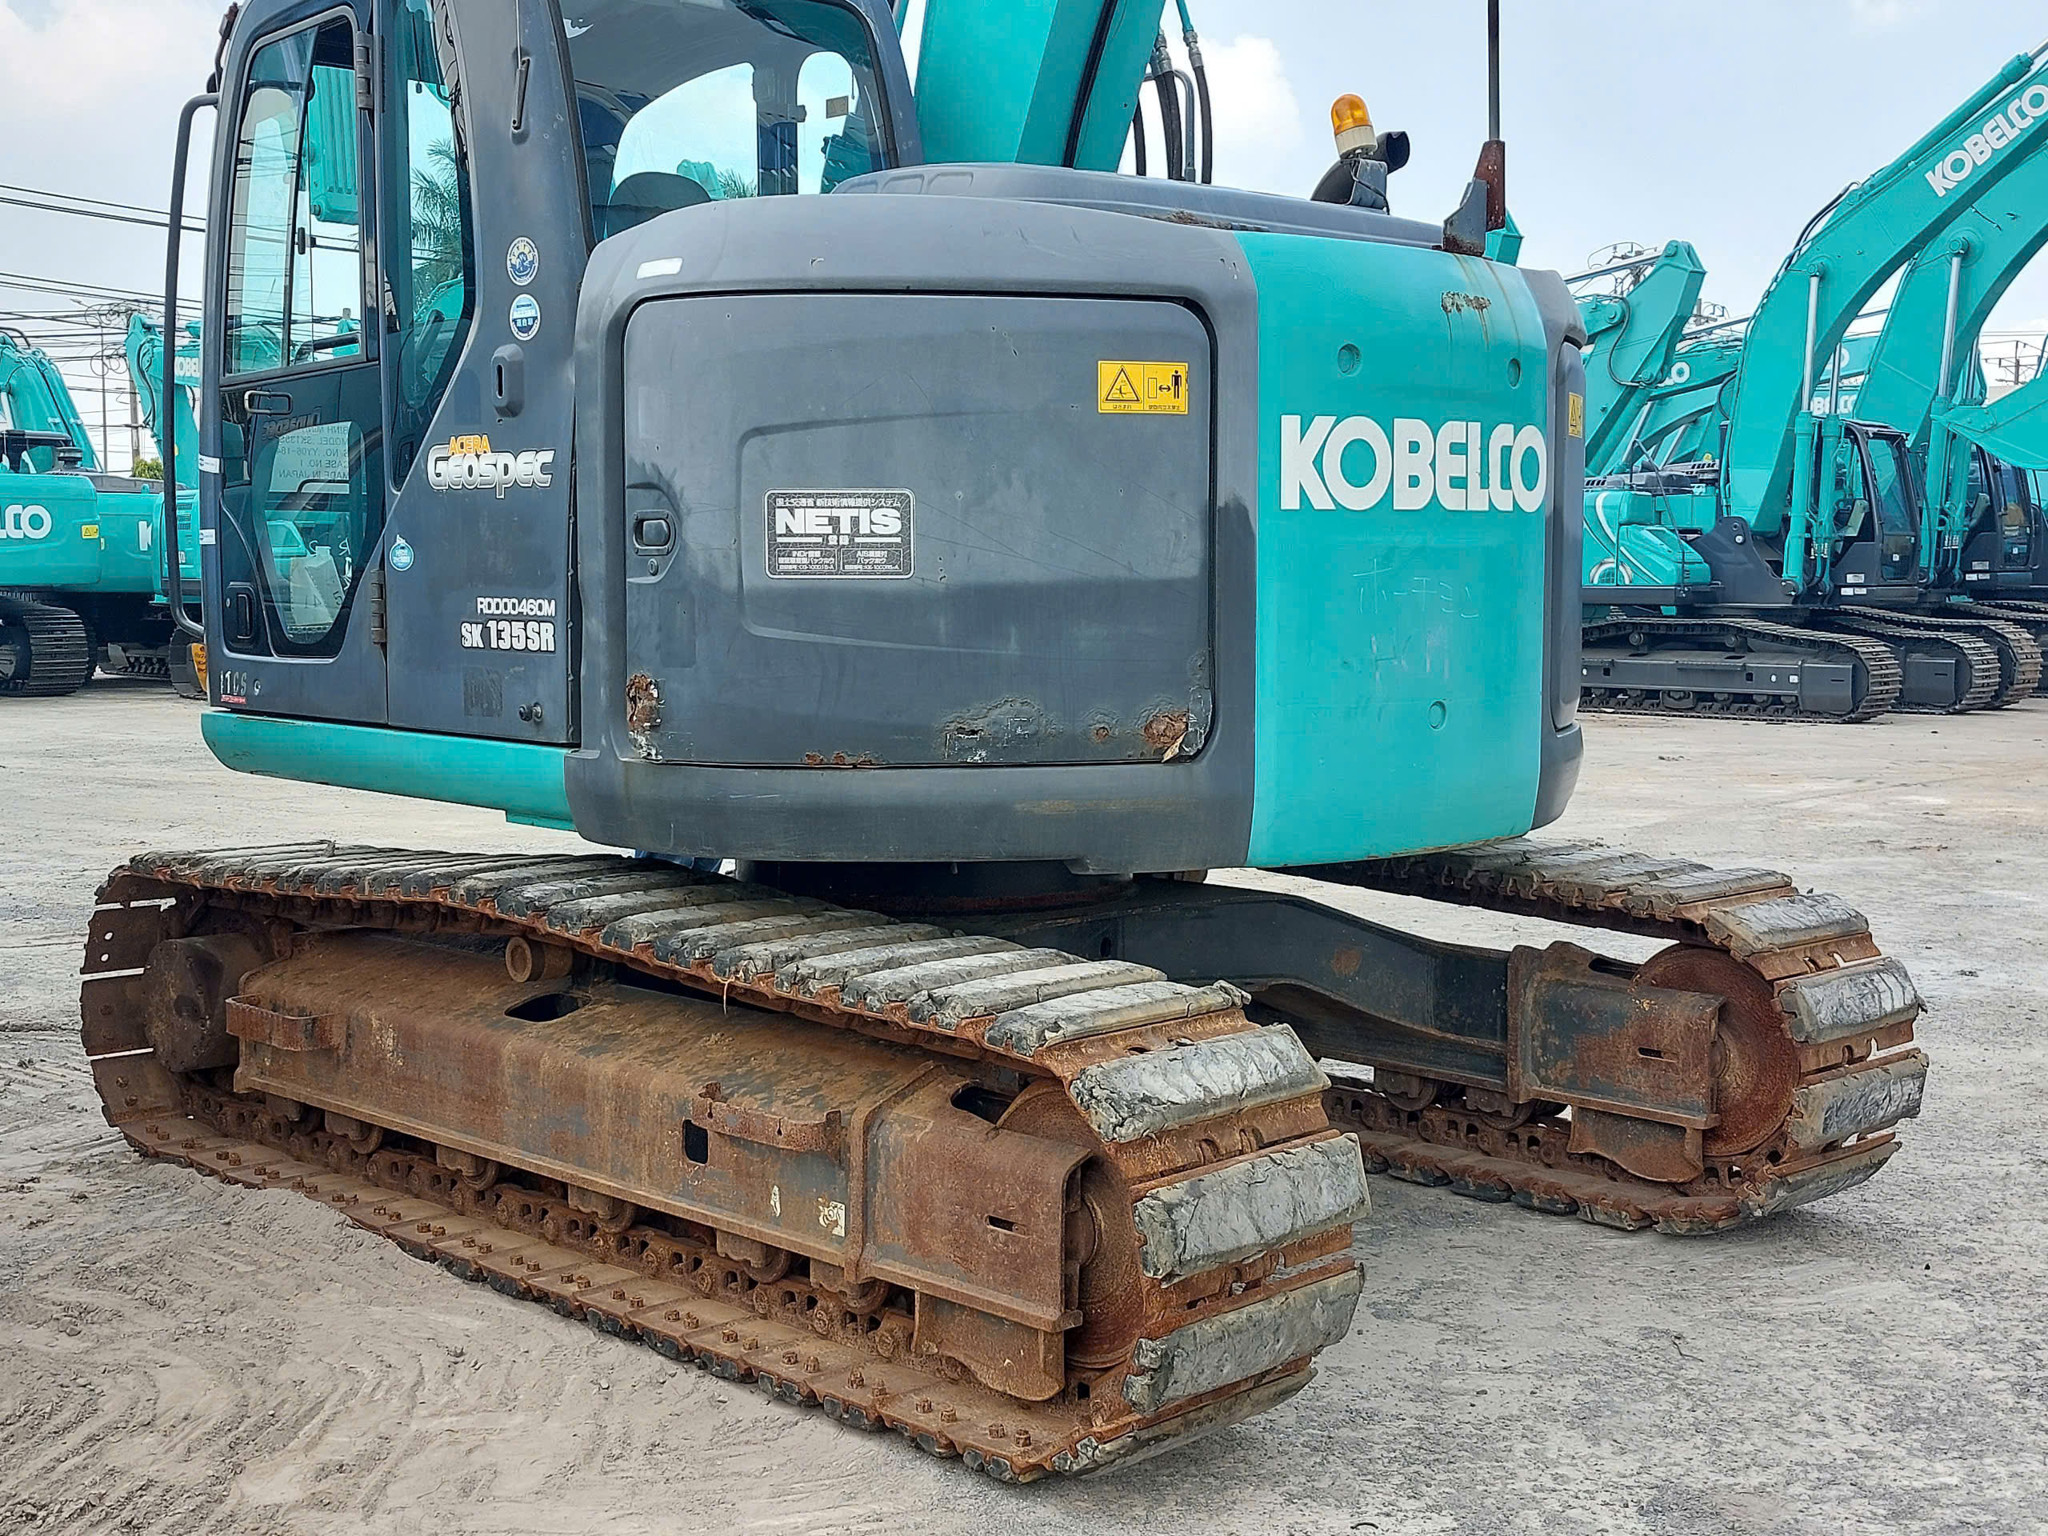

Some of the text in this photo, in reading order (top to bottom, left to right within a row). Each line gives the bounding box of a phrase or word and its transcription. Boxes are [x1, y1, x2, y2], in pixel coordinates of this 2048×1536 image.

[1924, 84, 2048, 197] KOBELCO
[449, 434, 491, 454] ACERA
[1280, 414, 1547, 513] KOBELCO
[775, 508, 902, 535] NETIS
